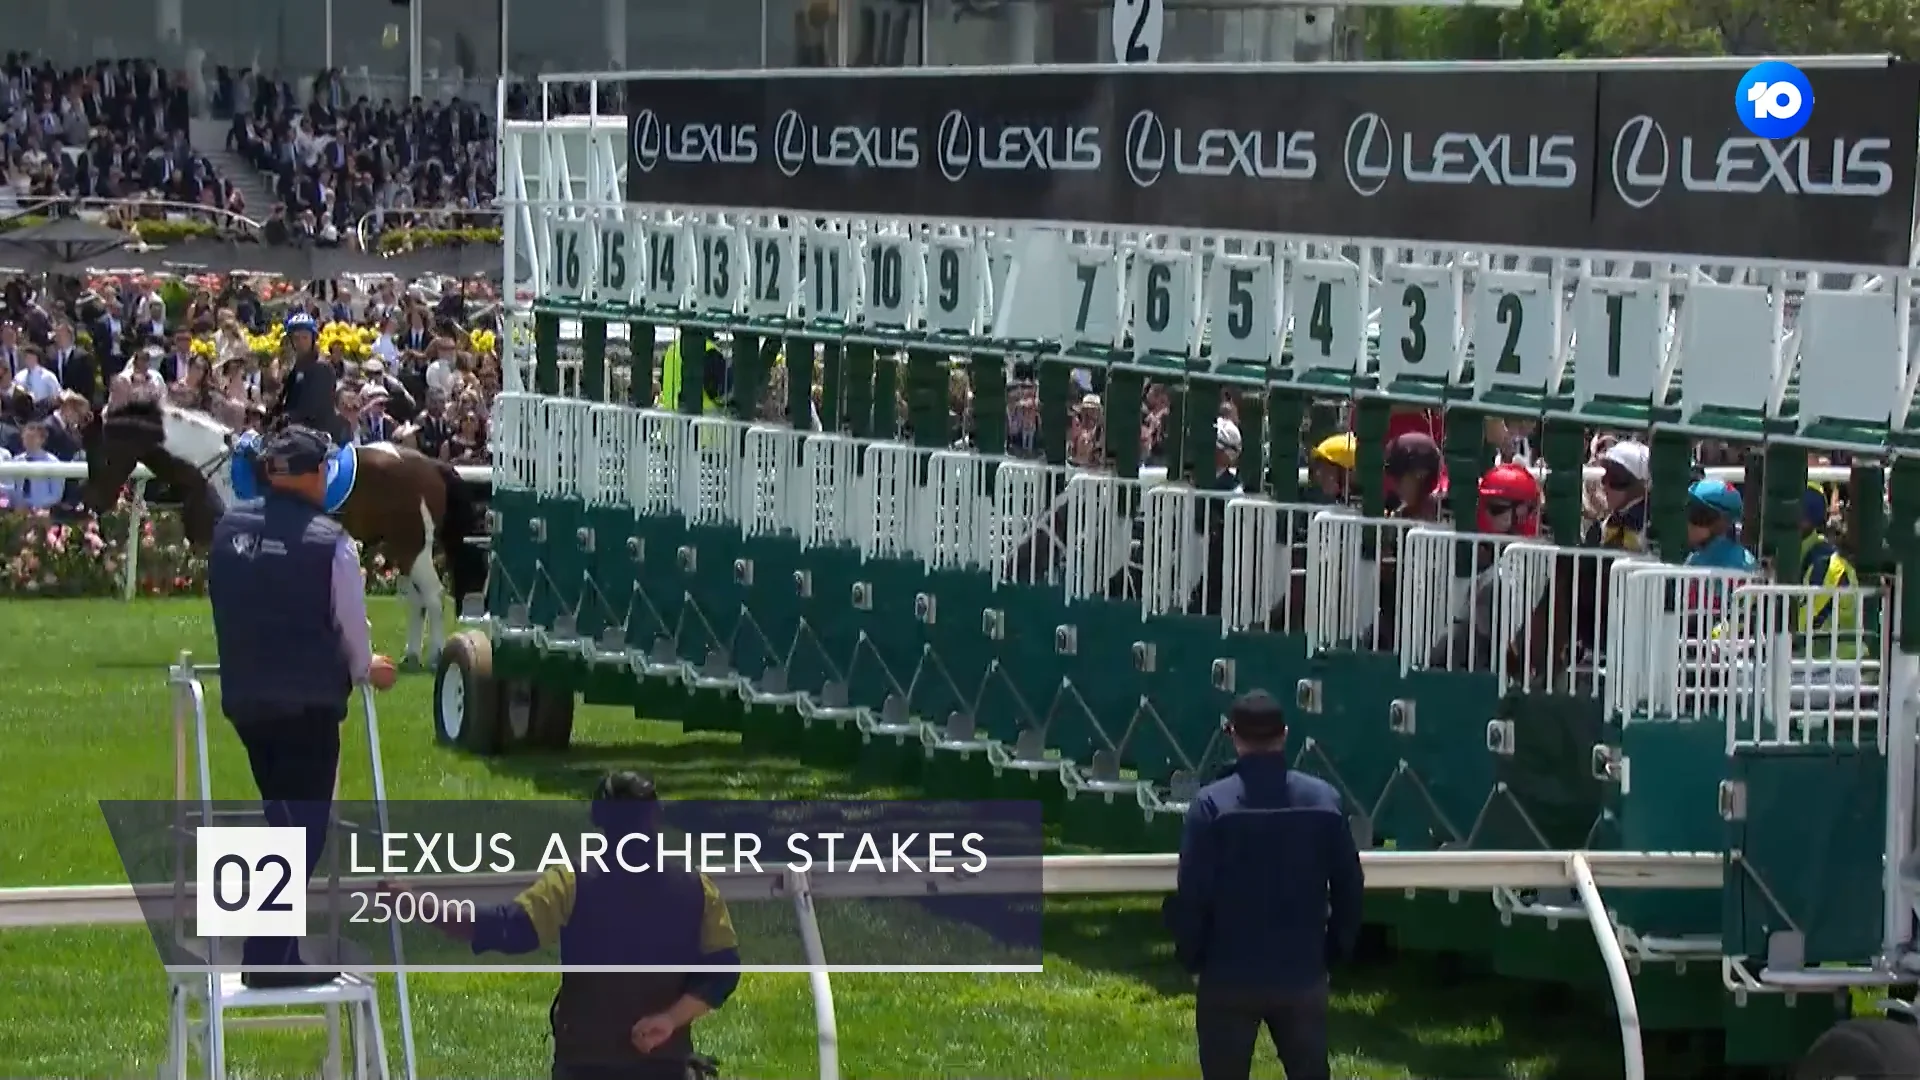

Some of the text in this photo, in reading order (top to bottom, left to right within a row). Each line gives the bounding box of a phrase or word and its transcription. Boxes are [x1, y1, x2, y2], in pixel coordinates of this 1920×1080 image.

[1126, 0, 1150, 62] 2
[665, 125, 758, 164] LEXUS
[812, 126, 920, 168] LEXUS
[978, 126, 1102, 170] LEXUS
[1174, 128, 1317, 179] LEXUS
[1403, 132, 1577, 187] LEXUS
[1682, 138, 1893, 196] LEXUS
[556, 230, 580, 289] 16
[602, 230, 626, 290] 15
[651, 231, 675, 292] 14
[703, 234, 729, 298] 13
[754, 237, 780, 301] 12
[814, 246, 839, 313] 11
[871, 243, 902, 309] 10
[939, 248, 959, 312] 9
[1075, 264, 1098, 334] 7
[1147, 262, 1172, 333] 6
[1228, 269, 1255, 341] 5
[1309, 281, 1333, 358] 4
[1401, 284, 1427, 365] 3
[1496, 292, 1523, 376] 2
[1606, 295, 1622, 378] 1
